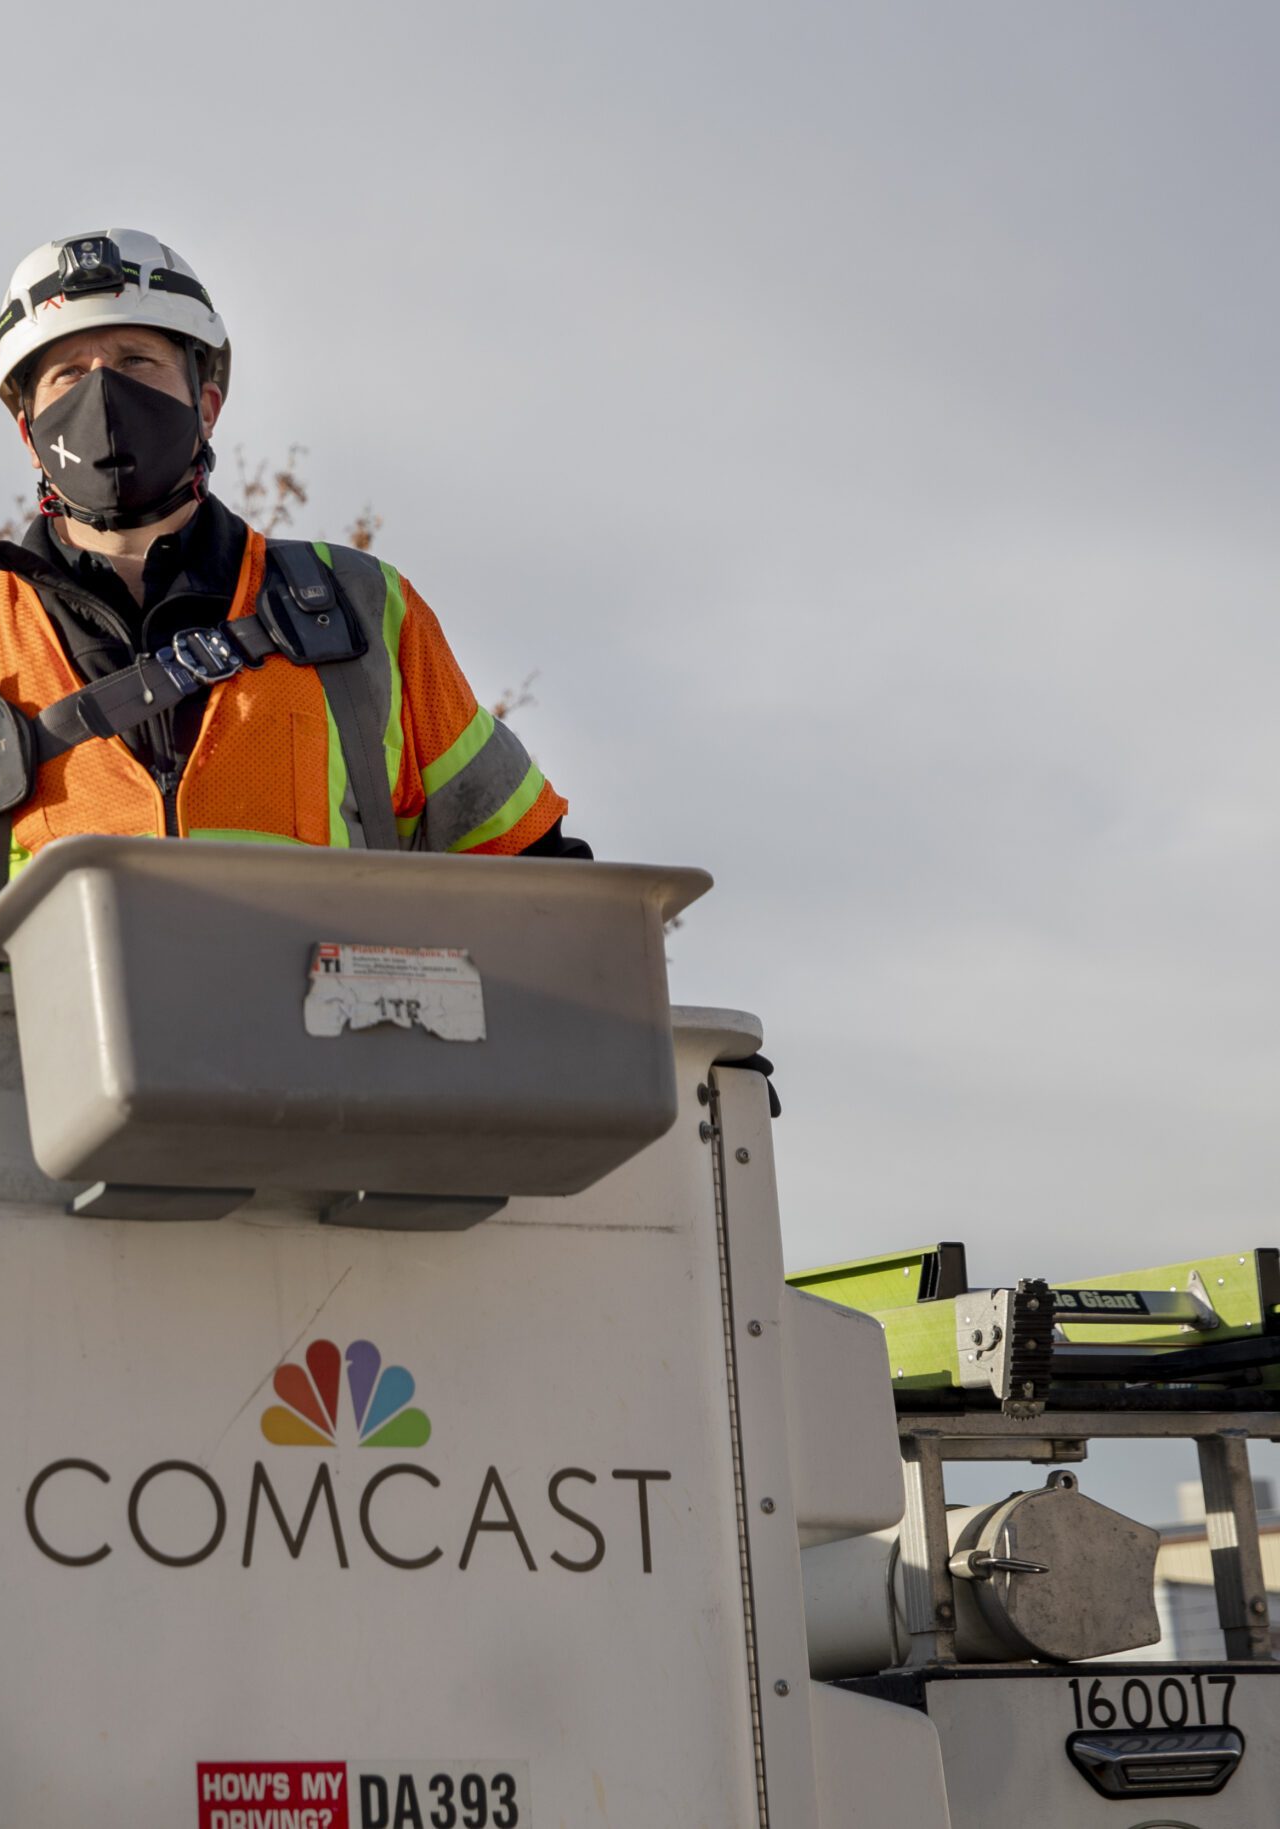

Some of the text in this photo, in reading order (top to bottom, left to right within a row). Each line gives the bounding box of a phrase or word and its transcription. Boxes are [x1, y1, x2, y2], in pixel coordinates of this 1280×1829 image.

[1078, 1291, 1141, 1309] Giant
[25, 1458, 671, 1573] COMCAST
[1068, 1675, 1237, 1730] 160017
[202, 1772, 344, 1801] HOW'S MY
[359, 1773, 519, 1829] DA393
[210, 1809, 333, 1829] DRIVING?
